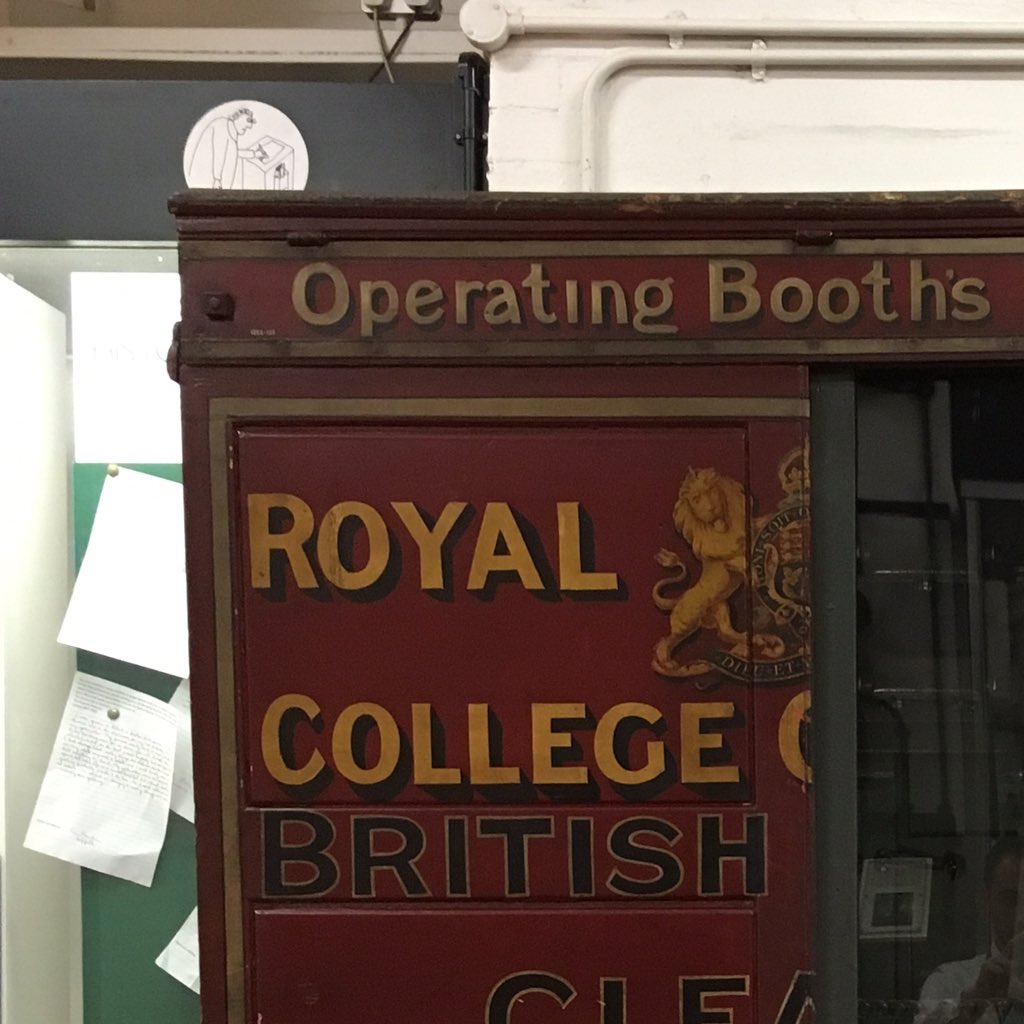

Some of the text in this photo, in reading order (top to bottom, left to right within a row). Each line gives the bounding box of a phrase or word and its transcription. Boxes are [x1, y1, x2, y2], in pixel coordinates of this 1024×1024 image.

[291, 260, 679, 336] Operating
[708, 257, 991, 324] Booth's
[247, 492, 620, 593] ROYAL
[261, 693, 741, 786] COLLEGE
[260, 809, 769, 898] BRITISH
